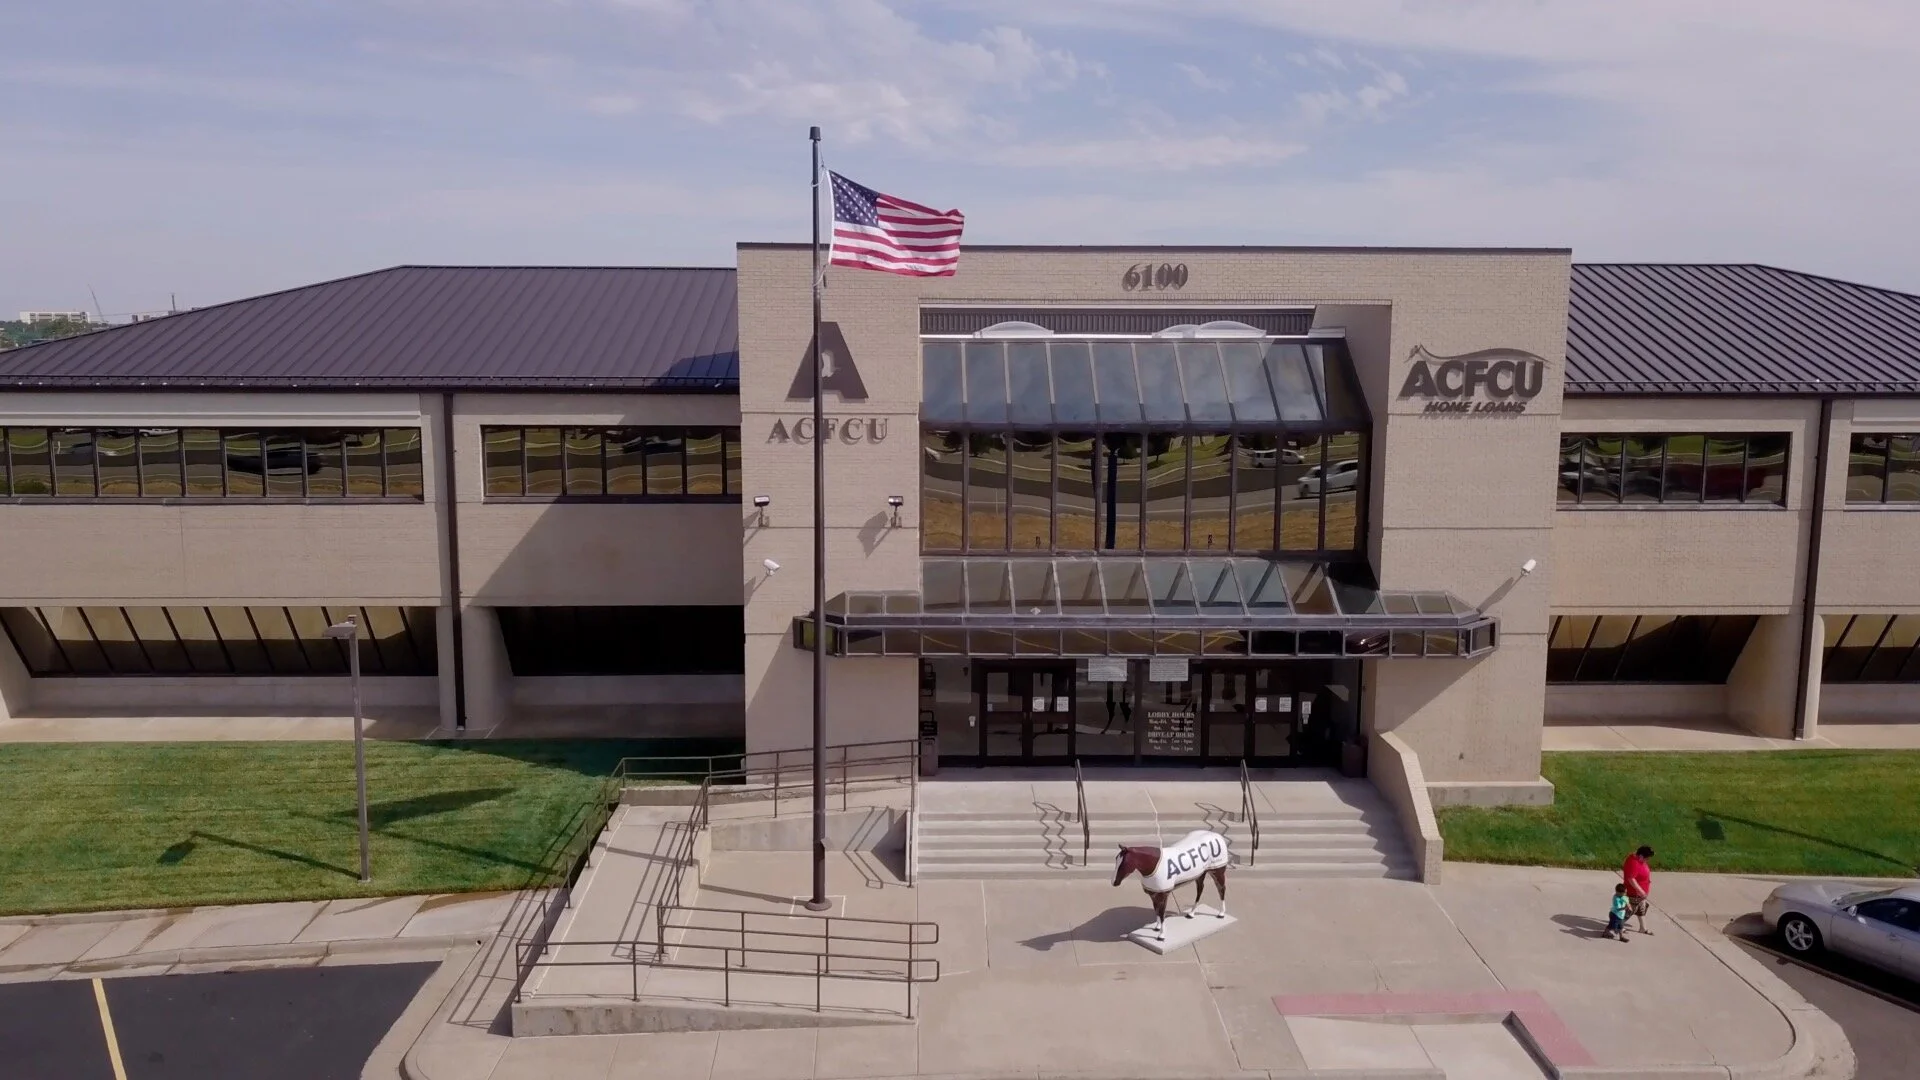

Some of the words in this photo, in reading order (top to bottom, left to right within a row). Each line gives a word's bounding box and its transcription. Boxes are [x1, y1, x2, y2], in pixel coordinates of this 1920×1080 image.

[1123, 263, 1188, 290] 6100
[1397, 360, 1544, 397] ACFCU
[1424, 402, 1471, 413] HOME
[1474, 402, 1527, 413] LOANS
[768, 417, 889, 440] ACFCU
[1166, 838, 1221, 880] ACFCU
